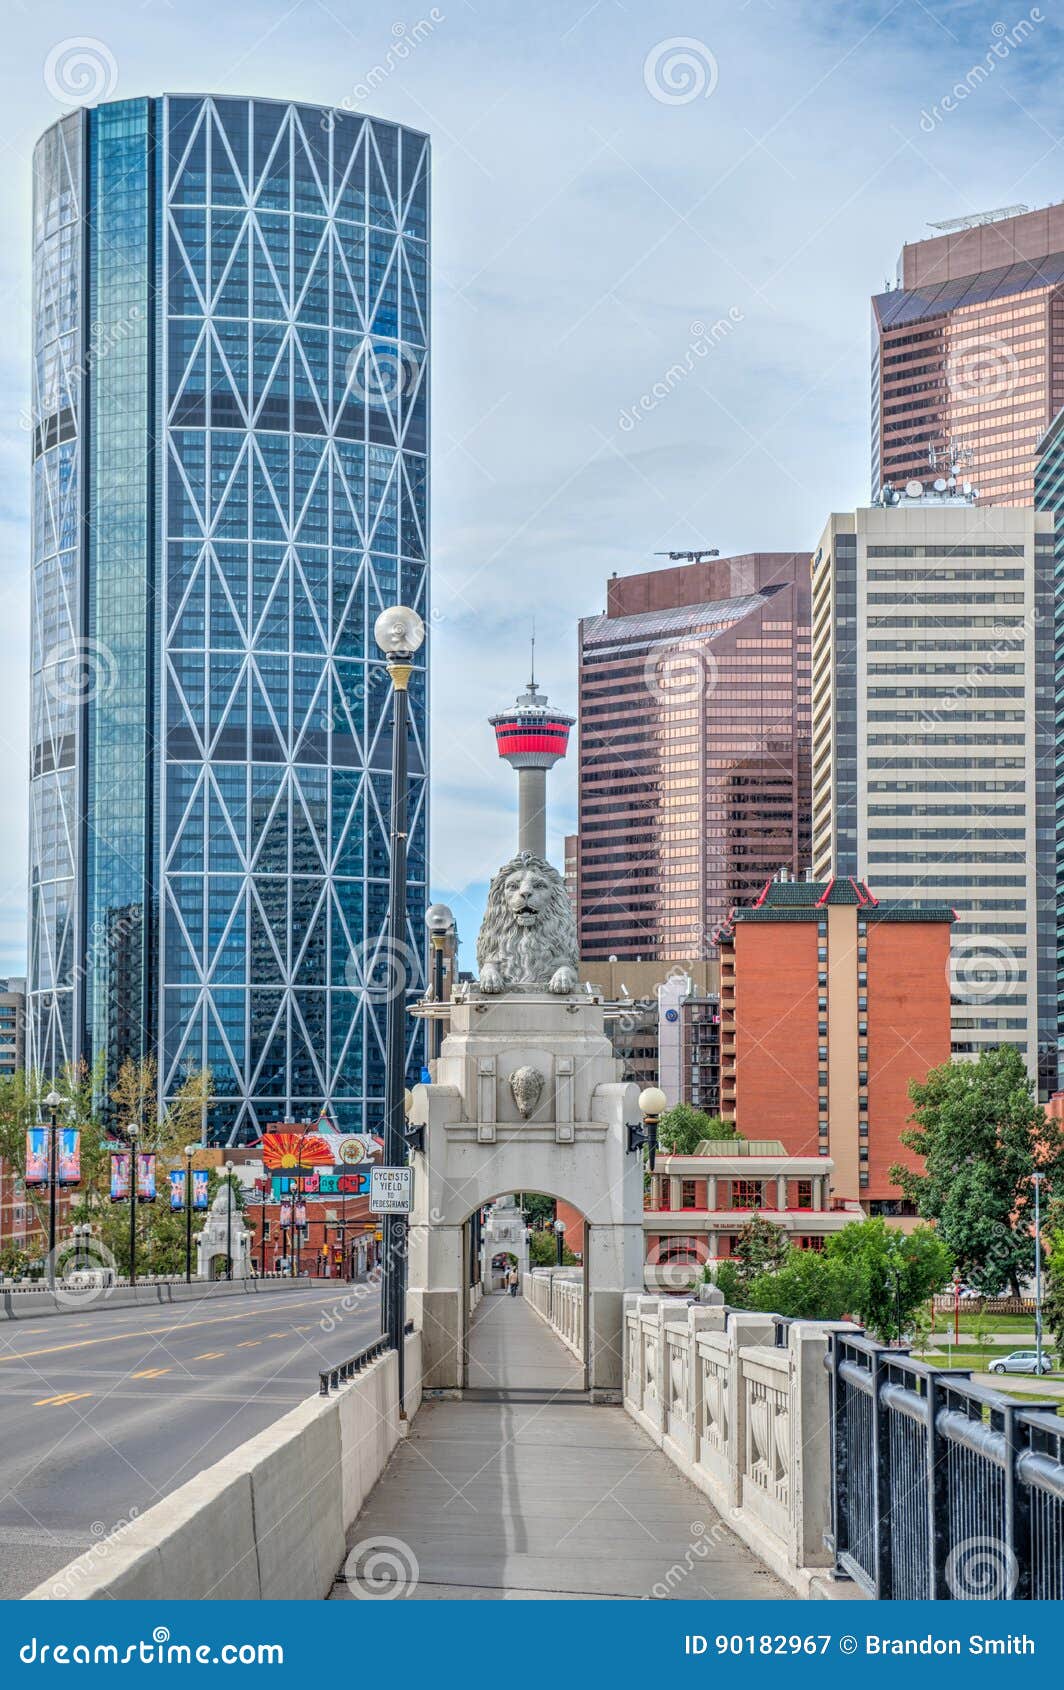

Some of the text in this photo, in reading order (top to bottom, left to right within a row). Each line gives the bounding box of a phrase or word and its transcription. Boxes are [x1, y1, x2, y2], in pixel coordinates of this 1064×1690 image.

[374, 1172, 408, 1181] CYCLISTS
[381, 1182, 402, 1191] YIELD
[387, 1191, 395, 1199] TO
[372, 1199, 409, 1208] PEDESTRIANS
